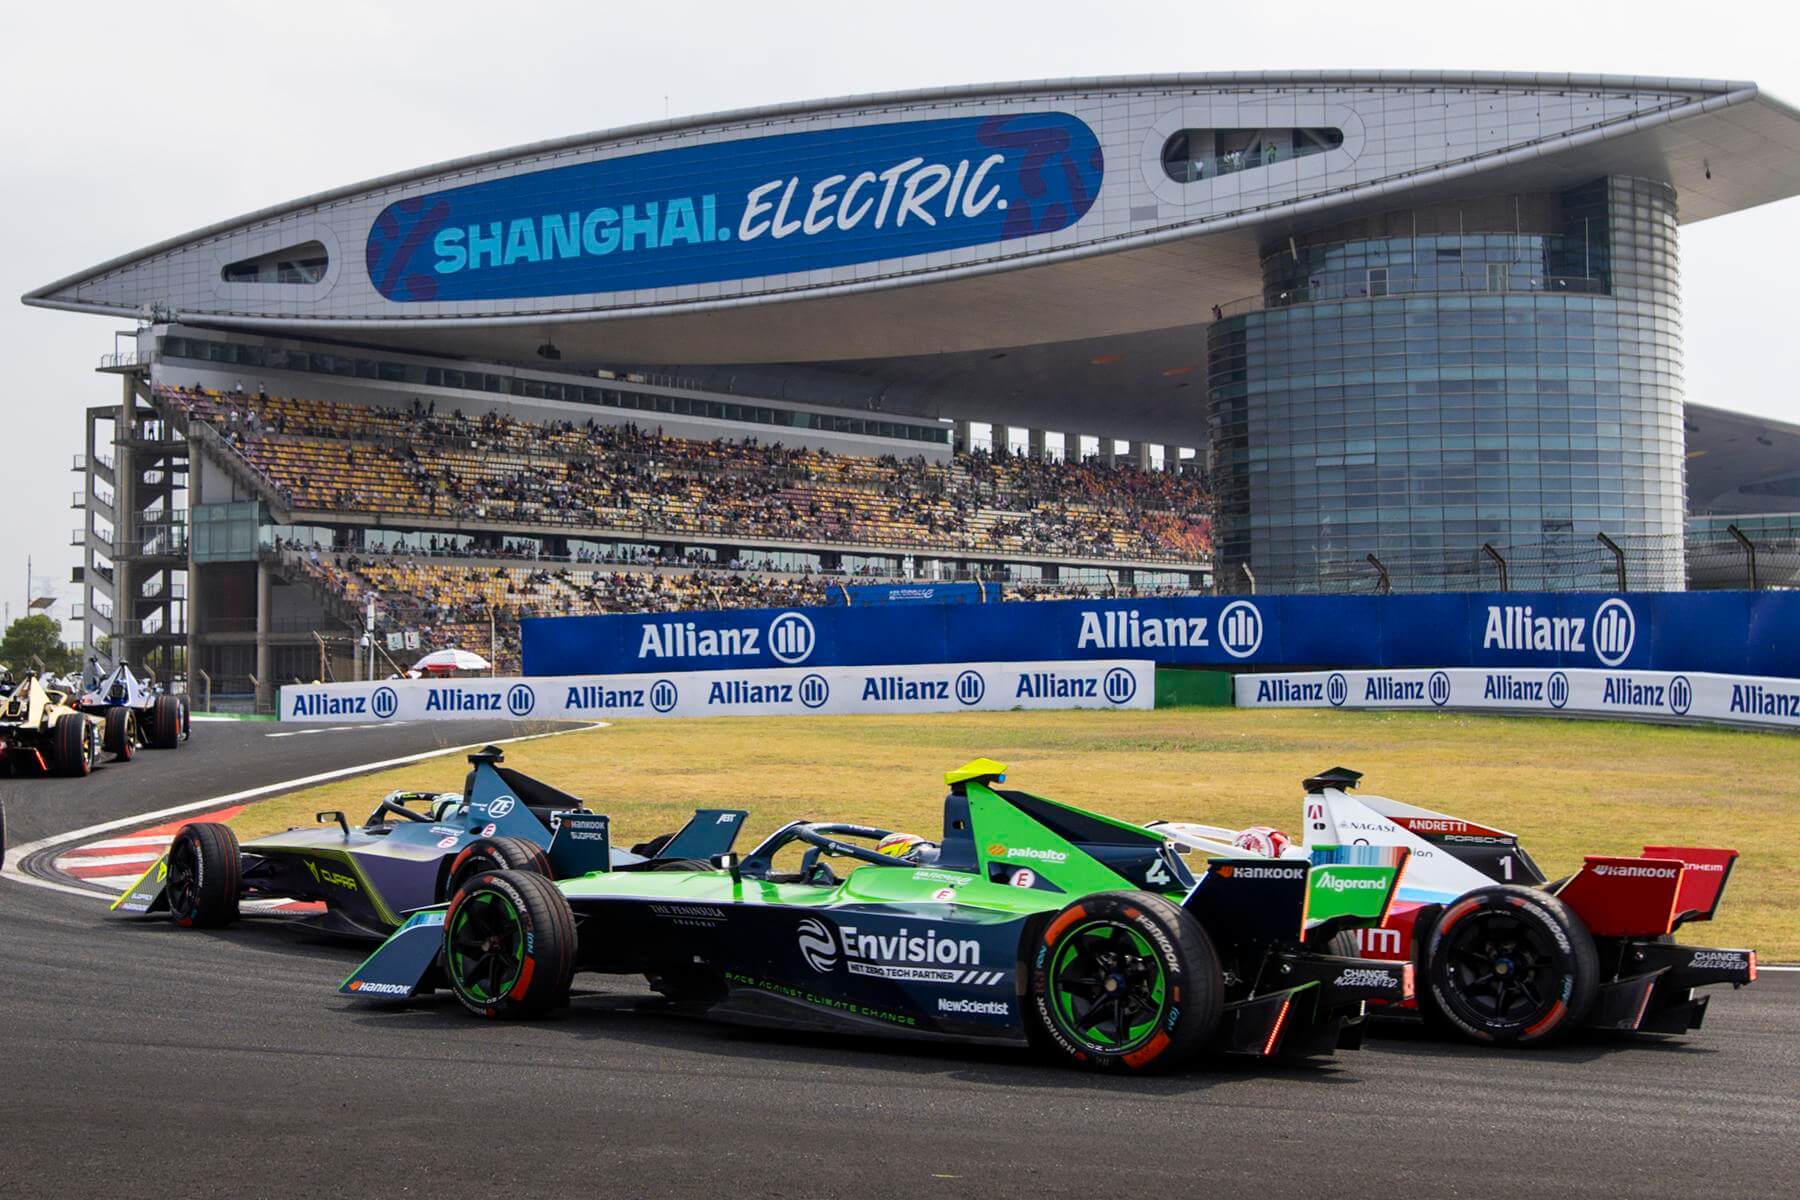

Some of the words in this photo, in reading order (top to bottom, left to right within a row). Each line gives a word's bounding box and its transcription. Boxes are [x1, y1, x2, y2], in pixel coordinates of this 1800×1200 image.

[433, 195, 730, 275] SHANGHAI.
[737, 153, 1010, 242] ELECTRIC.
[638, 622, 761, 658] Allianz
[1077, 611, 1208, 649] Allianz
[1483, 605, 1586, 652] Allianz
[710, 680, 793, 704] Allianz
[862, 677, 949, 701] Allianz
[1016, 673, 1097, 698] Allianz
[1257, 680, 1323, 702] Allianz
[1365, 677, 1424, 701] Allianz
[1484, 675, 1543, 701] Allianz
[1603, 677, 1664, 707] Allianz
[293, 694, 366, 716] Allianz
[426, 689, 501, 711] Allianz
[565, 686, 644, 710] Allianz
[1730, 684, 1800, 716] Allianz
[1351, 822, 1398, 833] NAGASE
[1408, 819, 1467, 833] ANDRETTI
[1444, 835, 1513, 844] PORSCHE
[1008, 847, 1066, 861] paloalto
[1016, 872, 1029, 887] E
[1146, 858, 1171, 885] 4
[1499, 855, 1512, 880] 1
[321, 869, 358, 891] CUPRA
[1315, 872, 1386, 892] Algorand
[671, 905, 726, 918] PENINSULA
[839, 926, 980, 965] Envision
[1694, 952, 1741, 961] CHANGE
[850, 963, 864, 975] NET
[865, 965, 885, 976] ZERO
[886, 966, 911, 978] TECH
[912, 969, 955, 981] PARTNER
[1343, 968, 1390, 978] CHANGE
[725, 972, 754, 985] RACE
[759, 980, 802, 997] AGAINST
[806, 993, 857, 1013] CLIMATE
[860, 1007, 916, 1025] CHANGE
